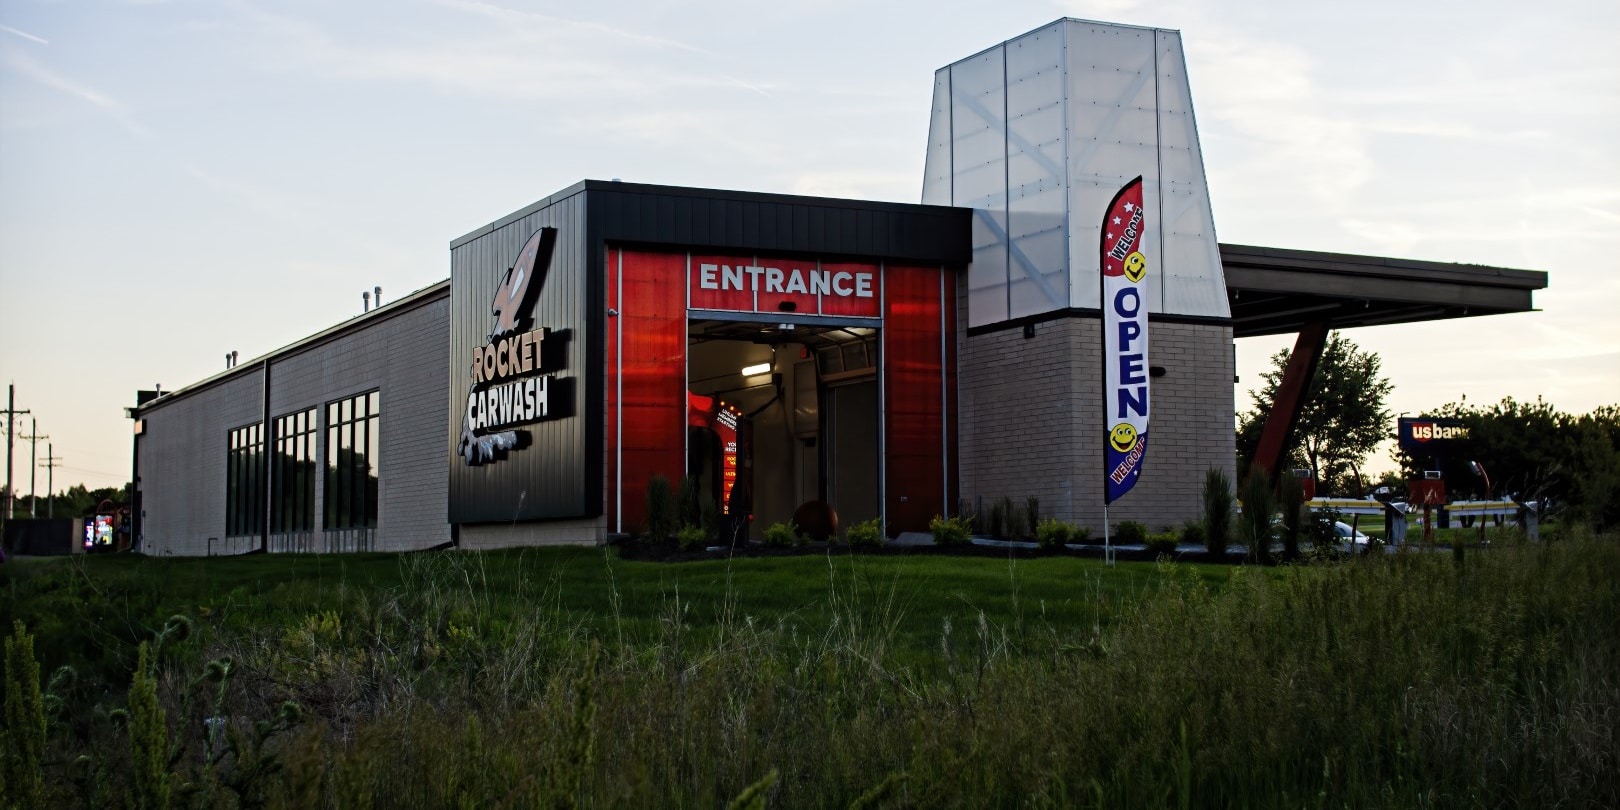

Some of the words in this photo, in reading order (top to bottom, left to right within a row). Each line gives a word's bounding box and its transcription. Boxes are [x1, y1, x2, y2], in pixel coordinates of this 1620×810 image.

[1111, 206, 1143, 261] WELCOME
[700, 263, 873, 298] ENTRANCE
[473, 328, 545, 383] ROCKET
[1114, 287, 1147, 418] OPEN
[467, 375, 548, 431] CARWASH
